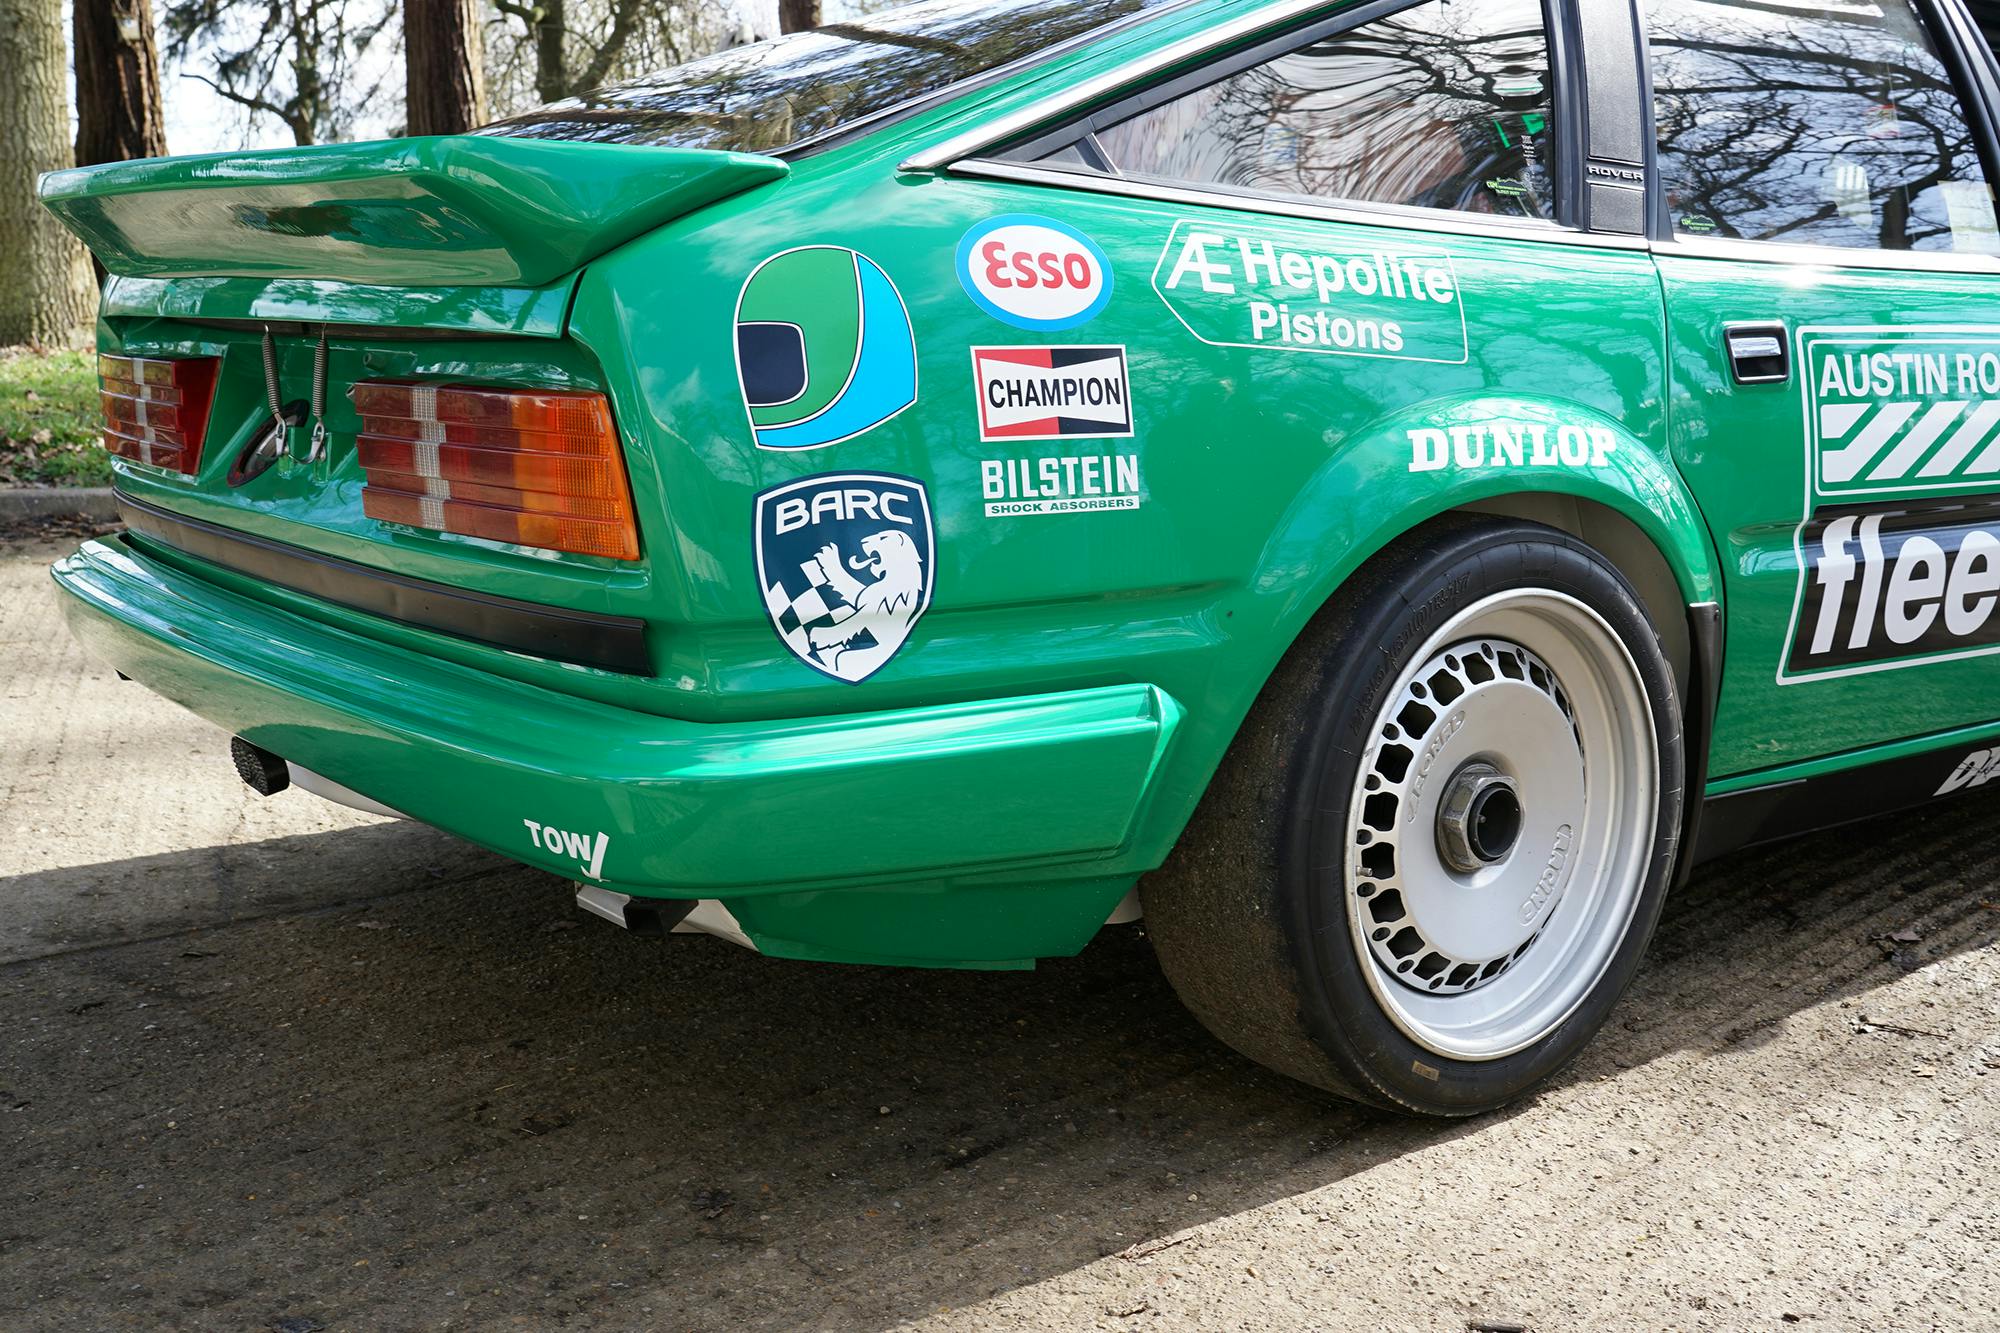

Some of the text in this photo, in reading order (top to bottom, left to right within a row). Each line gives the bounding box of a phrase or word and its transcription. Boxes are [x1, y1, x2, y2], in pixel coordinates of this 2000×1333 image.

[1588, 166, 1644, 181] ROVER
[1237, 237, 1454, 304] Hepolite
[1250, 301, 1405, 352] Pistons
[988, 376, 1122, 410] CHAMPION
[1819, 352, 1949, 398] AUSTIN
[1407, 424, 1617, 473] DUNLOP
[980, 454, 1140, 500] BILSTEIN
[775, 488, 914, 537] BARC
[991, 498, 1135, 515] SHOCK ABSORBERS
[1809, 514, 2000, 656] flee
[523, 818, 592, 862] TOW
[1519, 826, 1572, 923] RACING
